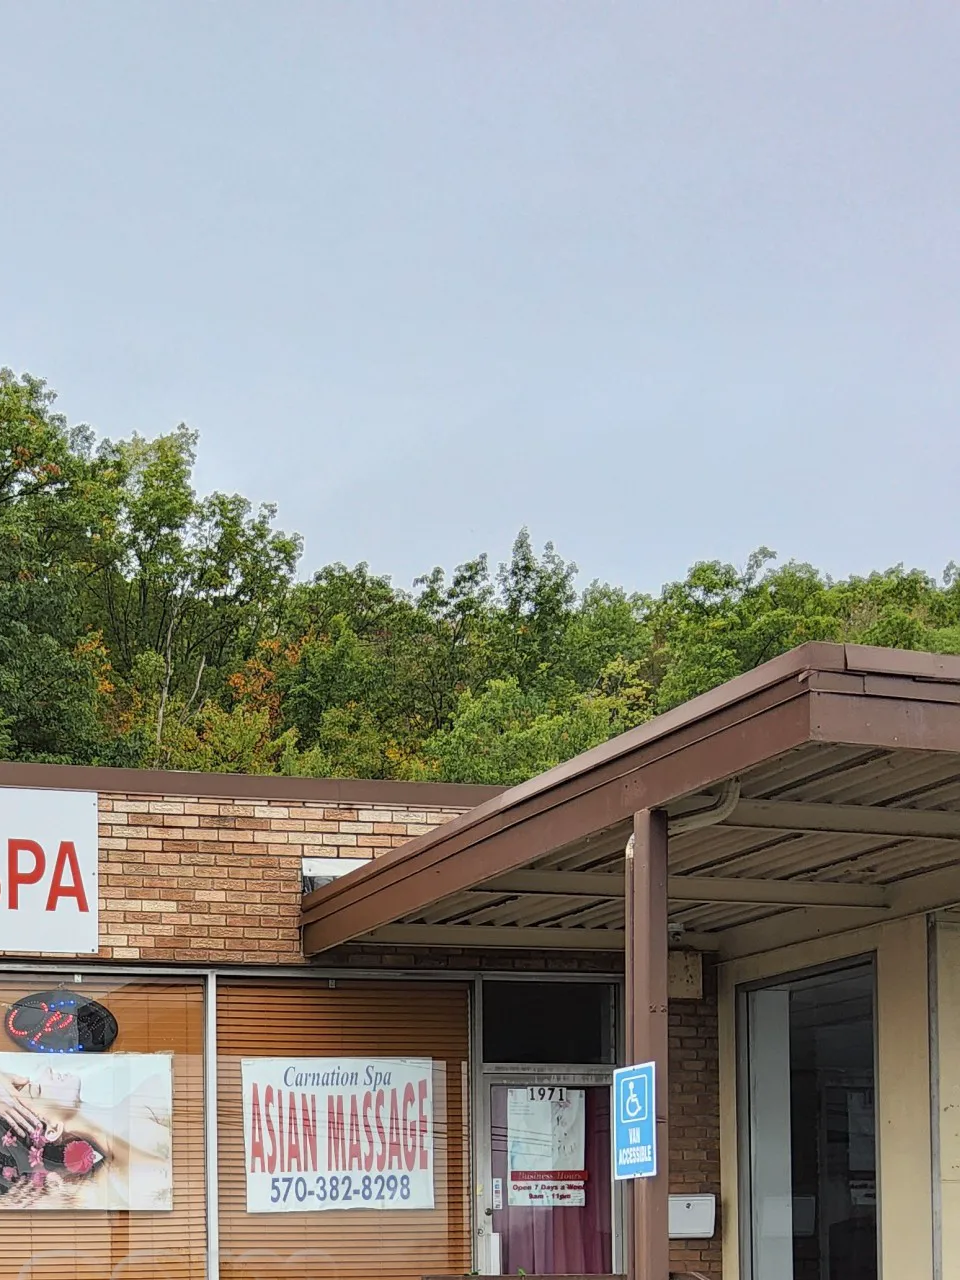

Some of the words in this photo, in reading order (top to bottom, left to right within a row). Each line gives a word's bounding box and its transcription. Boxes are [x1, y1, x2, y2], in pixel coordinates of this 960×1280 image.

[283, 1065, 358, 1088] Carnation
[363, 1065, 392, 1092] Spa
[529, 1087, 565, 1101] 1971
[250, 1082, 318, 1174] ASIAN
[327, 1079, 429, 1173] MASSAGE
[628, 1127, 641, 1144] VAN
[618, 1144, 652, 1165] ACCESSIBLE
[518, 1171, 554, 1180] Business
[556, 1172, 582, 1180] Hours
[270, 1174, 411, 1203] 570-382-8298
